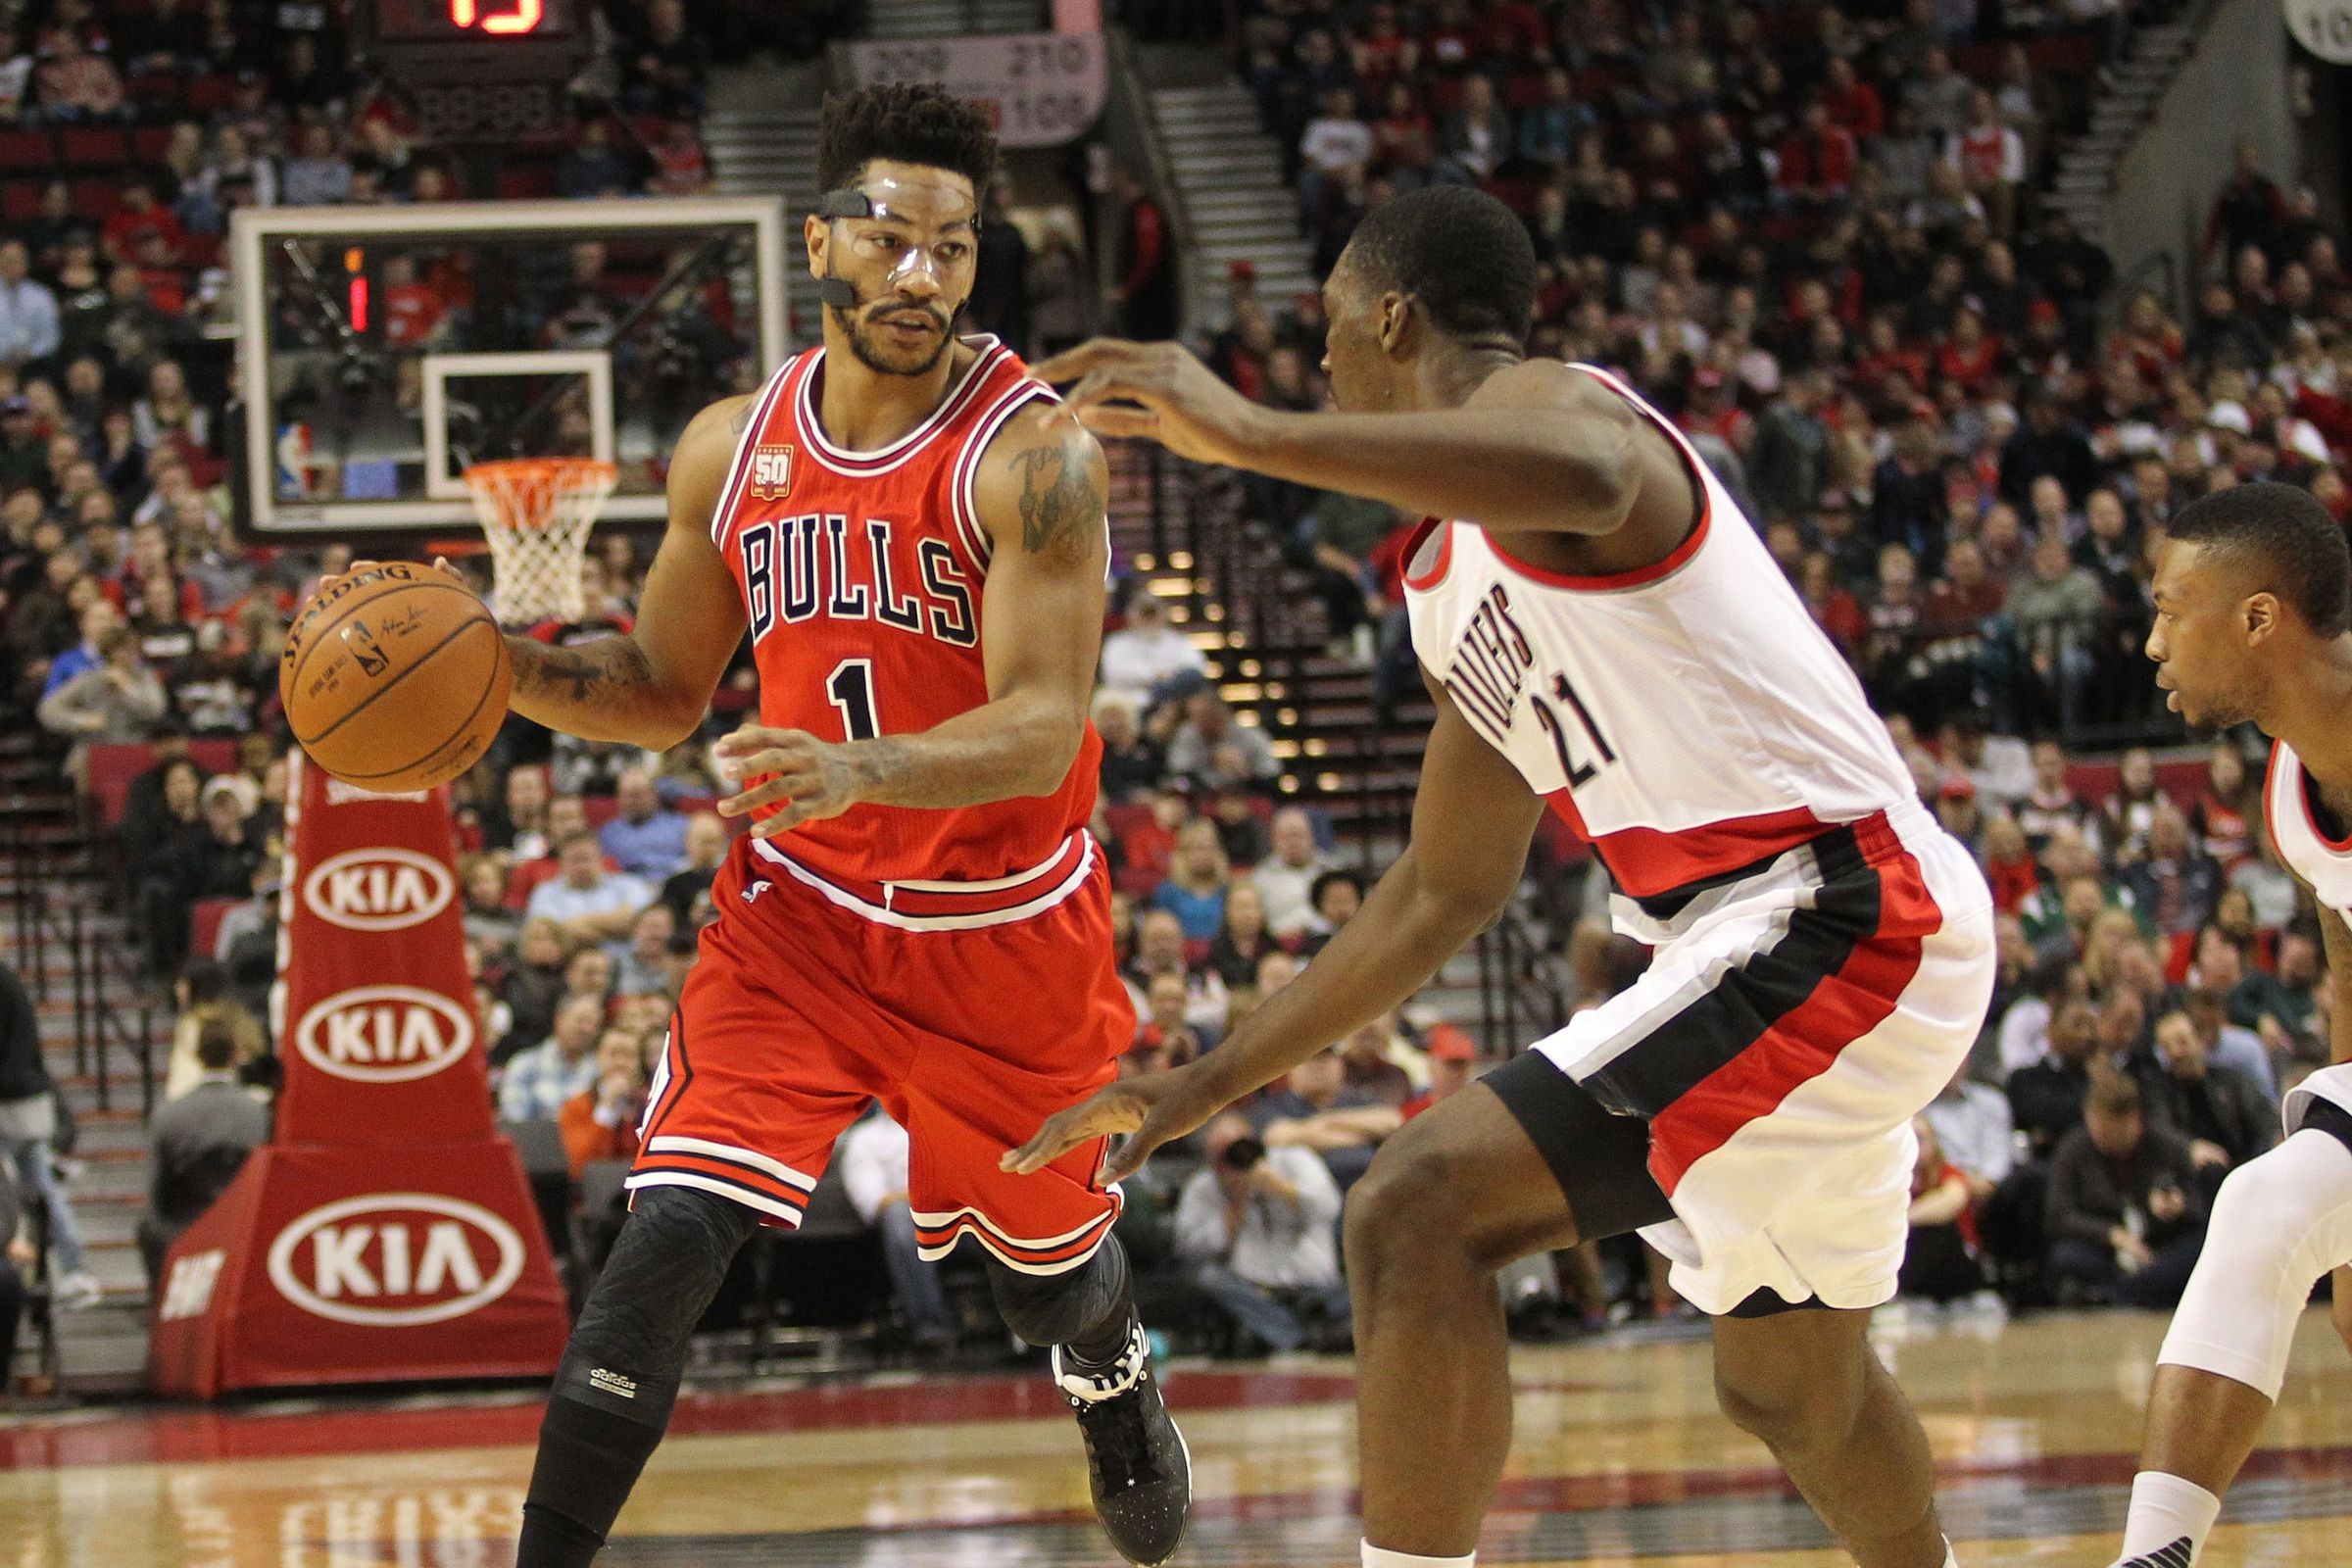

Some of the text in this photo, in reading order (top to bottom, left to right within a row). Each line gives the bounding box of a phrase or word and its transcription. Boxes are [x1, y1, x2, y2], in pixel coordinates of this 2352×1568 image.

[755, 454, 789, 486] 50
[740, 513, 978, 649] BULLS
[825, 659, 881, 743] 1
[1529, 673, 1617, 789] 21
[329, 864, 429, 913] KIA
[326, 1005, 445, 1063] KIA
[312, 1220, 484, 1299] KIA
